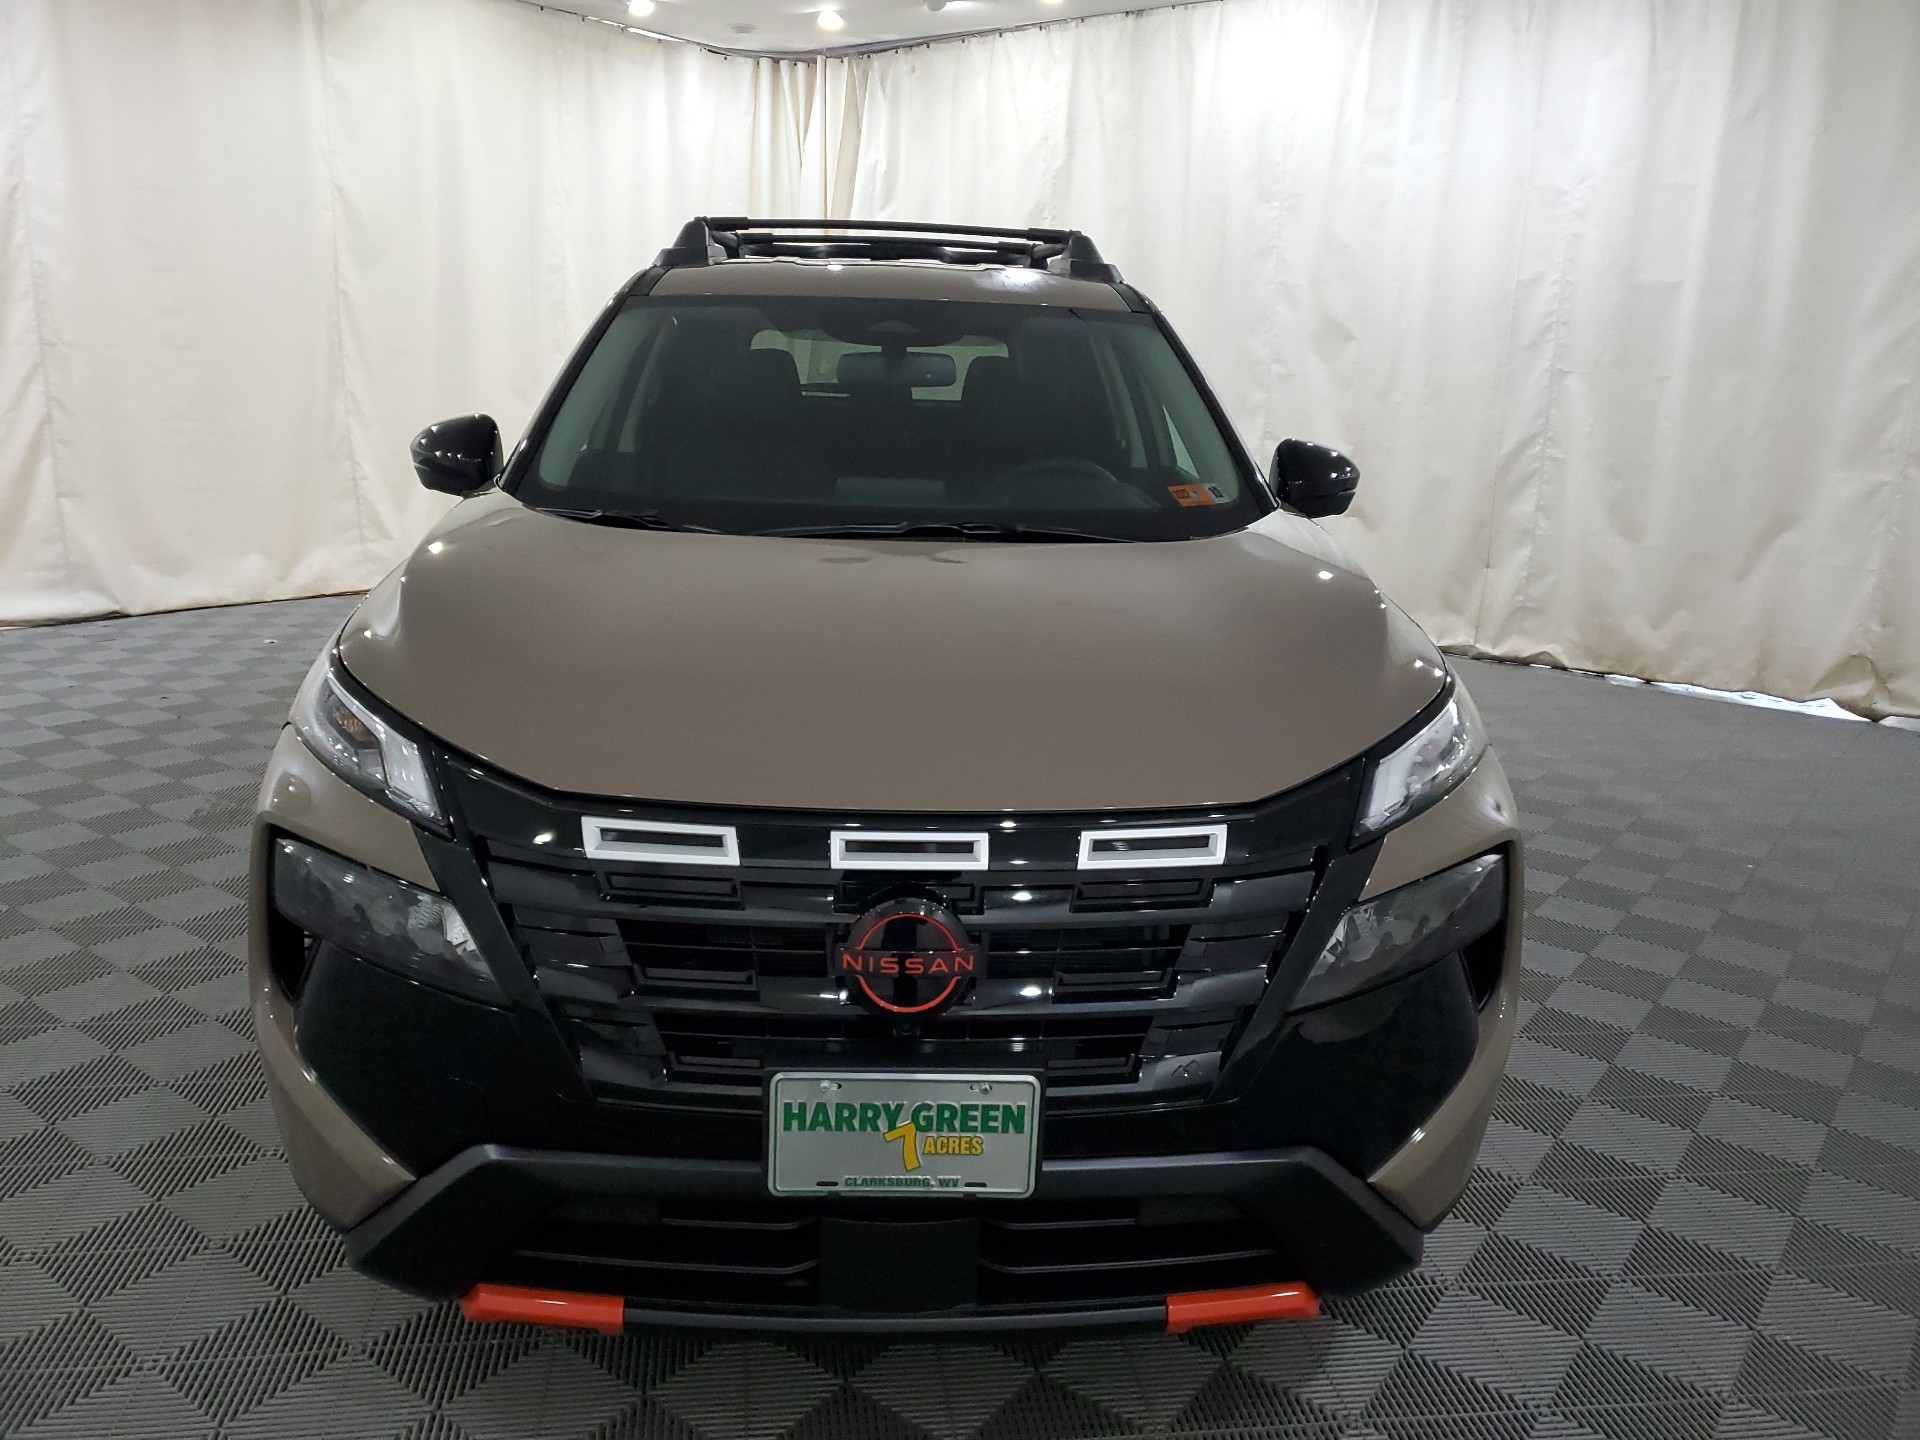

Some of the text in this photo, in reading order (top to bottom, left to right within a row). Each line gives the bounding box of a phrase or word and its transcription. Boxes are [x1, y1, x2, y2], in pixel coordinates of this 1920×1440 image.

[842, 953, 974, 974] NISSAN
[783, 1101, 1026, 1134] HARRY GREEN
[883, 1122, 984, 1172] 7 ACRES
[939, 1176, 960, 1188] WV
